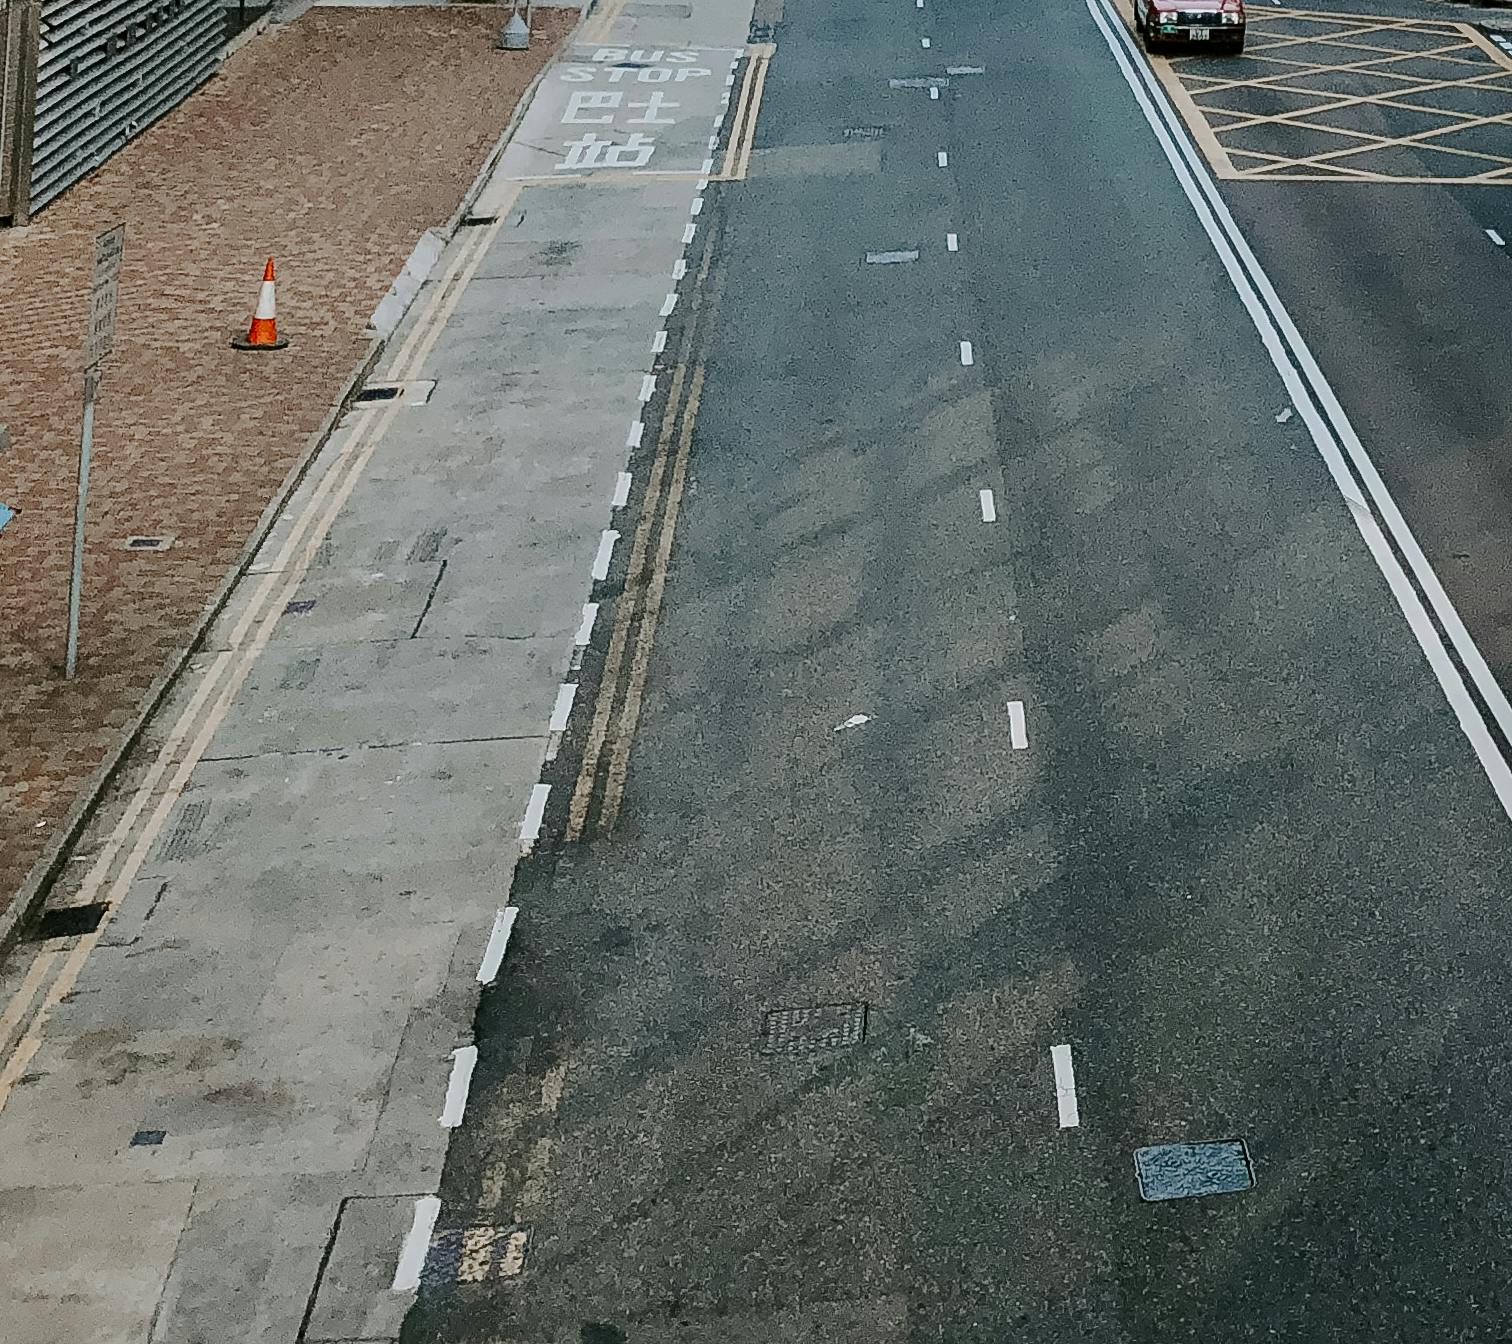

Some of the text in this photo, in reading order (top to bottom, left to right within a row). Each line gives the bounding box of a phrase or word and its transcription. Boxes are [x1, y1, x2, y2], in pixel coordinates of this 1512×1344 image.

[592, 48, 701, 62] BUS
[560, 66, 712, 83] STOP
[560, 91, 680, 124] 巴士
[554, 133, 656, 170] 站
